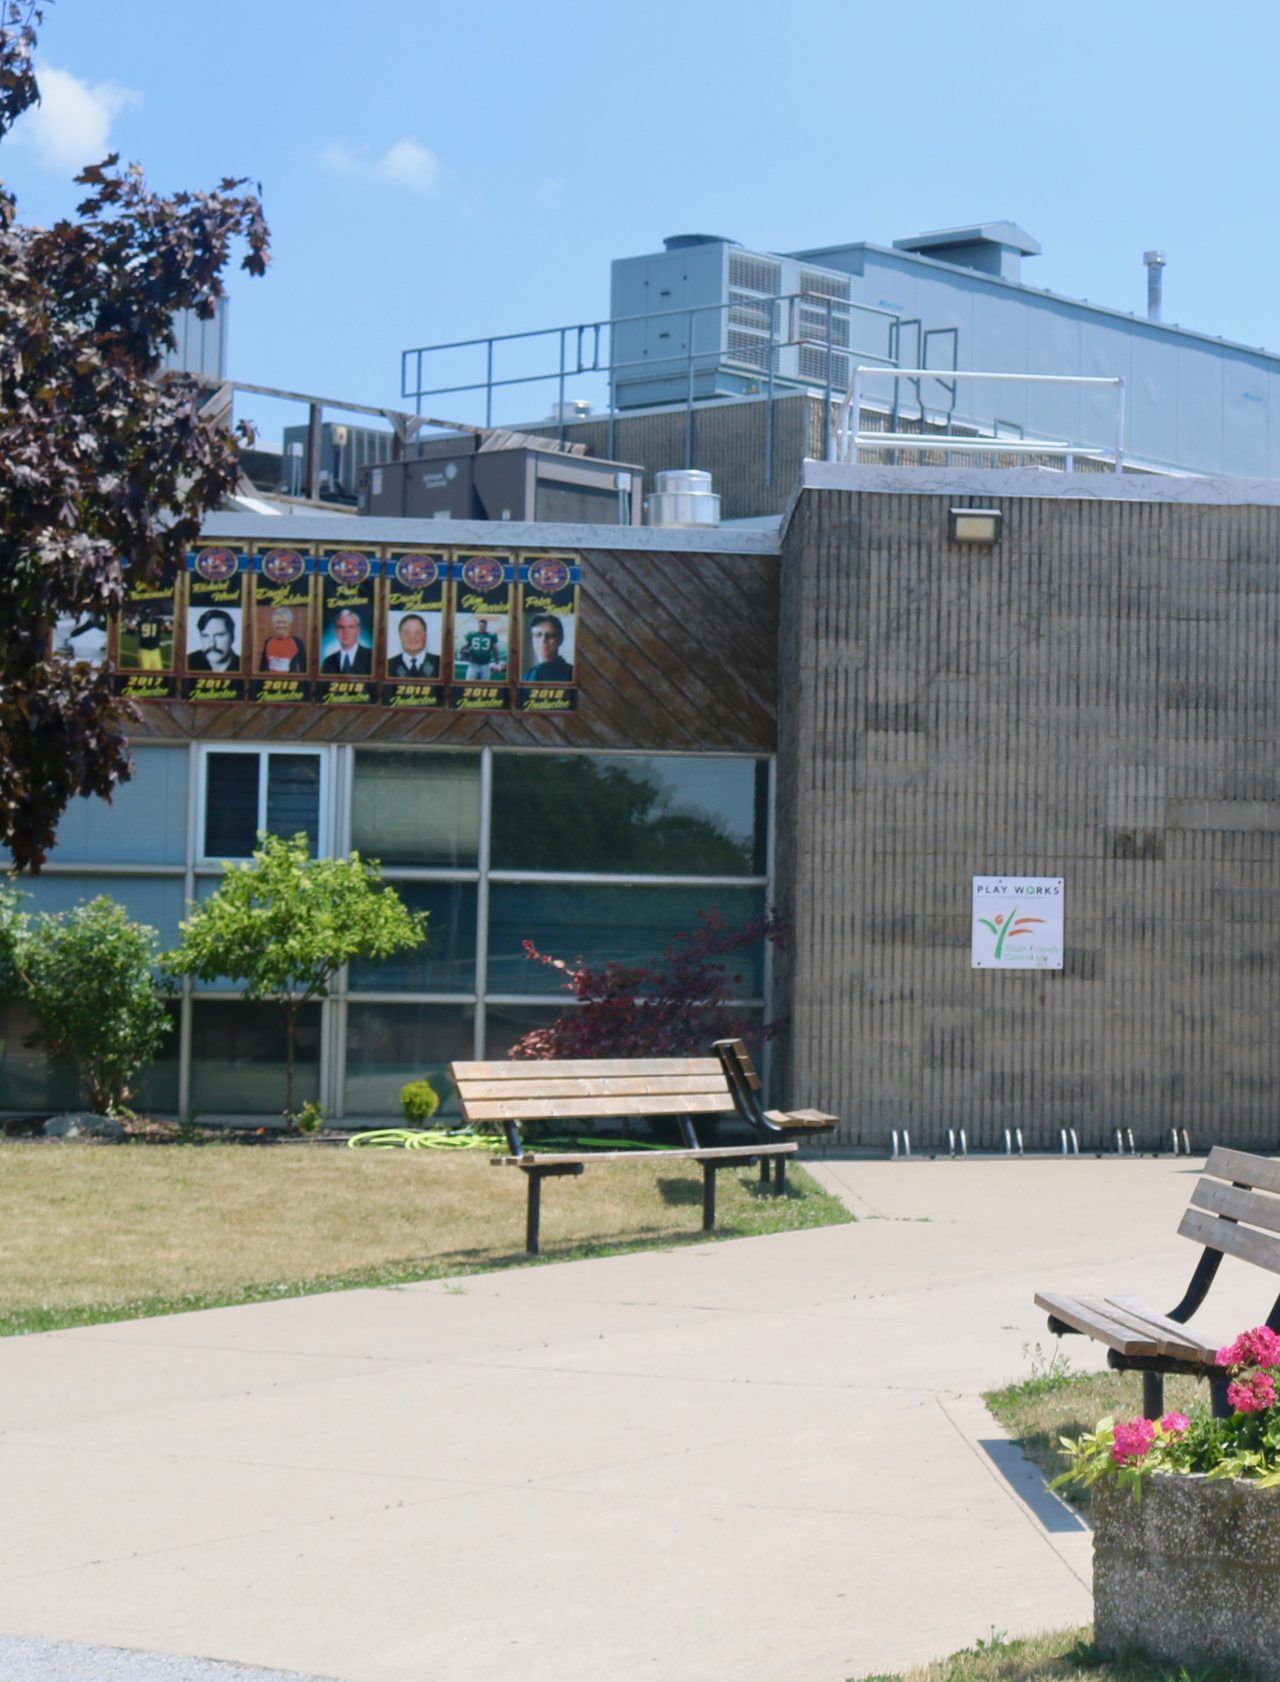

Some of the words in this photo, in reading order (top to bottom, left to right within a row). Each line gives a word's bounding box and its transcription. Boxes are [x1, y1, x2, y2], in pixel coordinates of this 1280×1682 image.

[141, 623, 157, 637] 91
[471, 637, 491, 650] 63
[127, 676, 164, 685] 2017
[196, 679, 231, 689] 2017
[463, 688, 498, 698] 2018
[530, 689, 565, 699] 2018
[977, 885, 1007, 894] PLAY
[1014, 886, 1060, 895] WORKS
